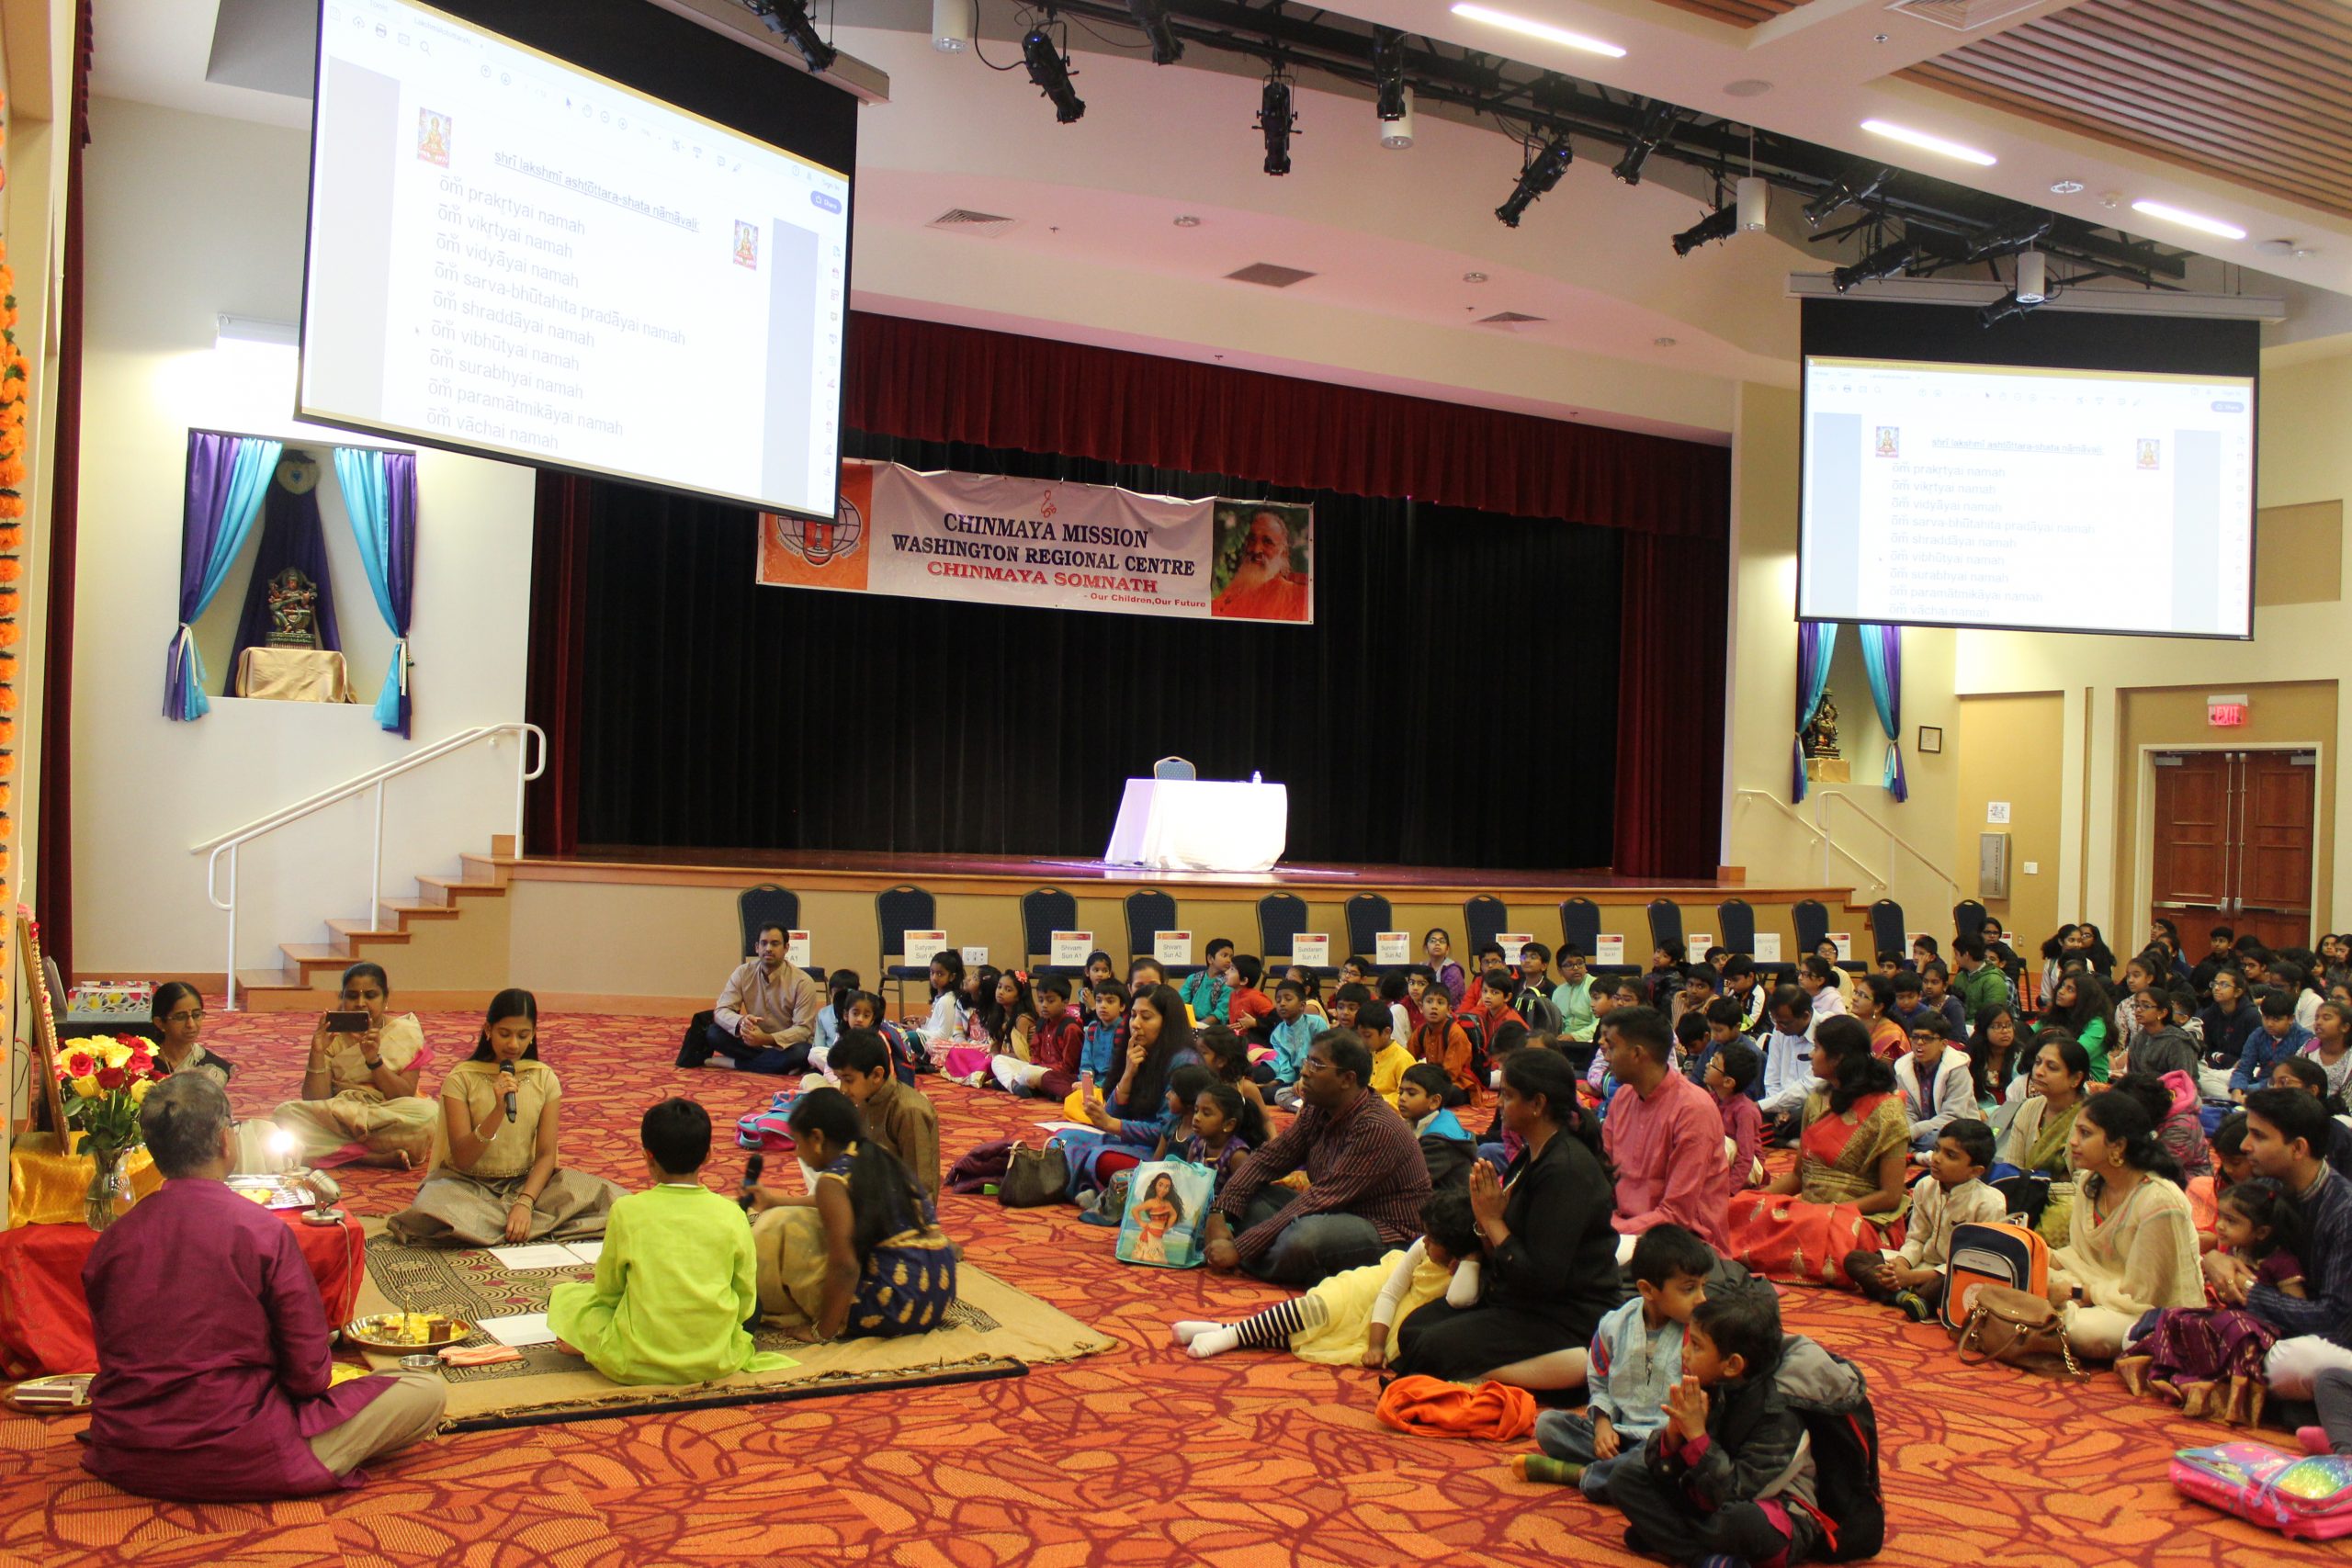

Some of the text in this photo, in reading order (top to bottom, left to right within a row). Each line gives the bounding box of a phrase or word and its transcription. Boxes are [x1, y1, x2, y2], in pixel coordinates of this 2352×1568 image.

[538, 210, 585, 235] namah
[526, 233, 572, 259] namah
[531, 263, 579, 288] namah
[548, 323, 594, 348] namah
[643, 323, 685, 346] namah
[532, 349, 579, 372] namah
[536, 377, 583, 400] namah
[577, 413, 623, 436] namah
[510, 428, 559, 450] namah
[944, 512, 1057, 541] CHINMAYA
[891, 533, 1195, 576] WASHINGTON REGIONAL CENTRE
[926, 559, 1159, 593] CHINMAYA SOMNATH
[1091, 592, 1108, 601] Our
[1174, 600, 1206, 608] Future
[2216, 705, 2239, 725] EXIT
